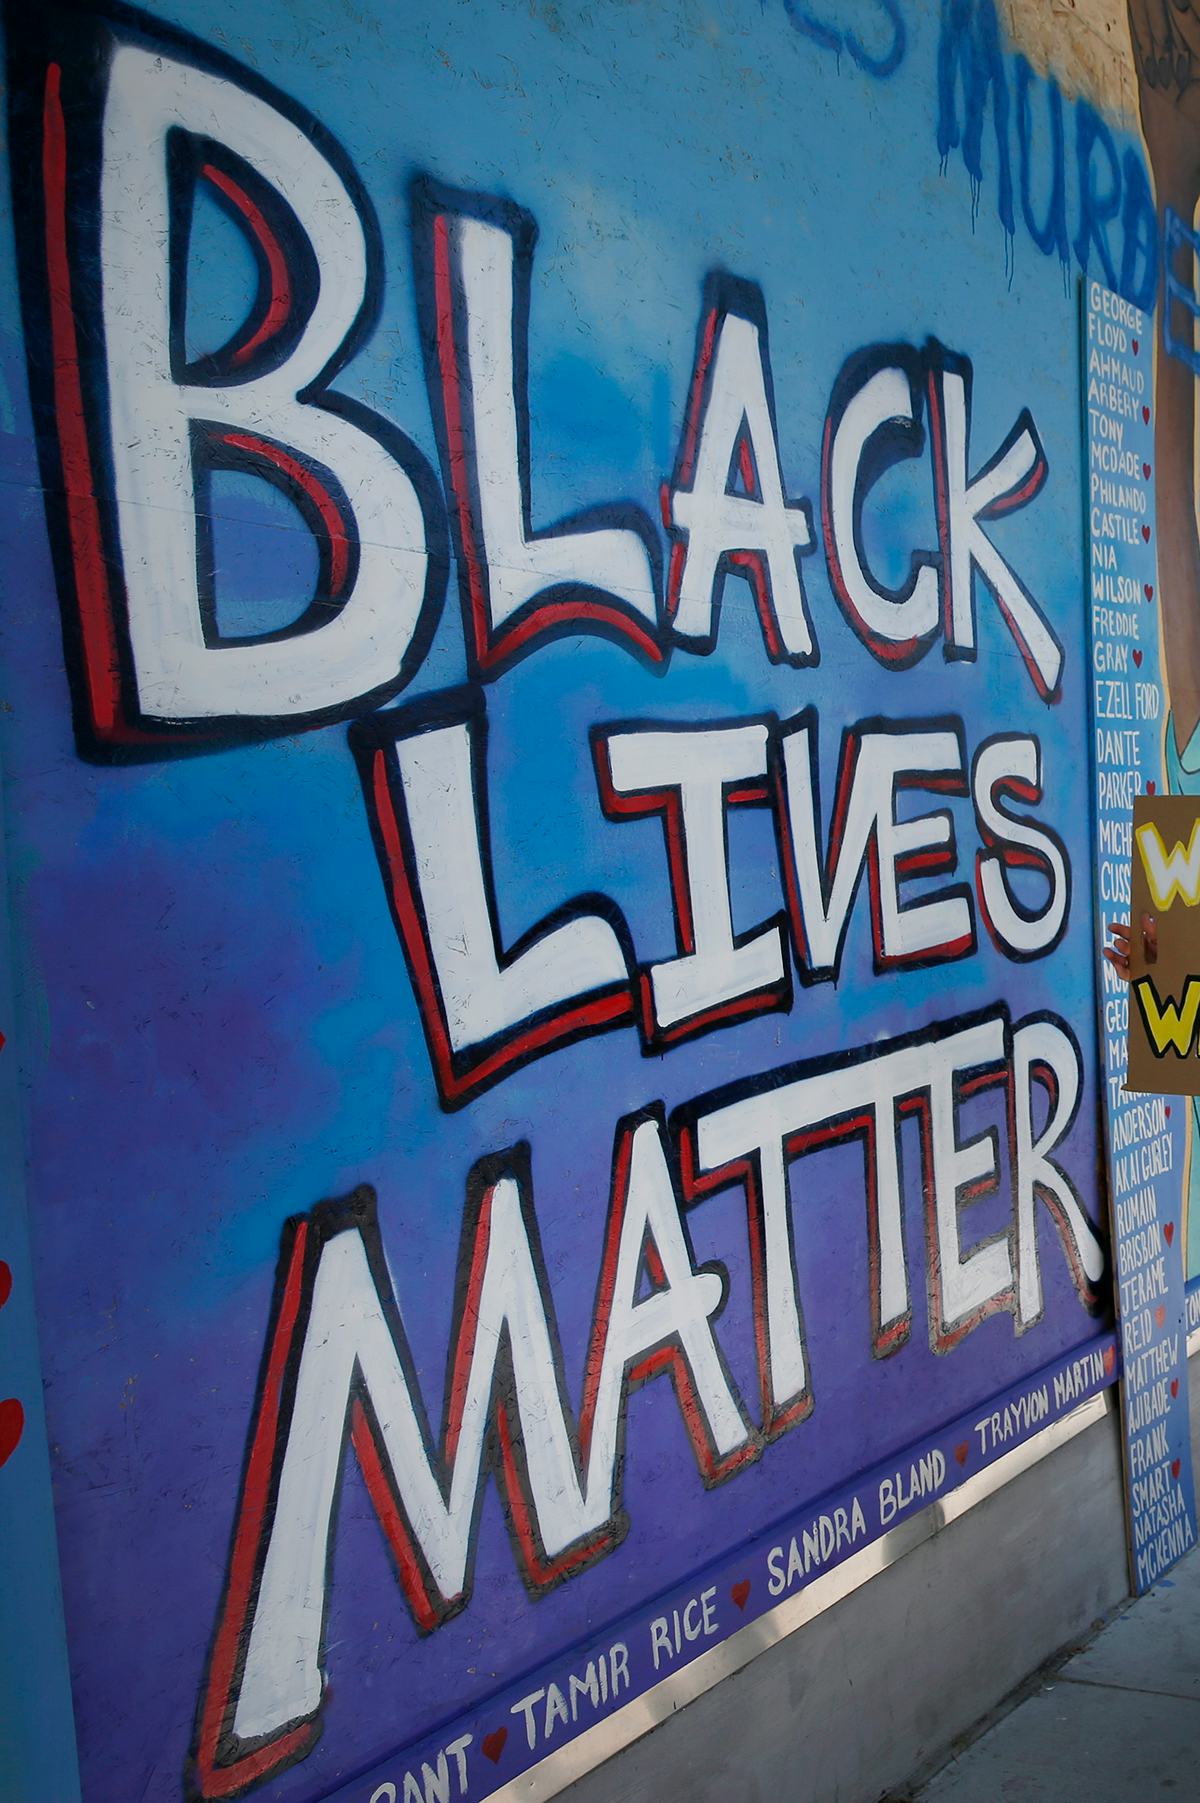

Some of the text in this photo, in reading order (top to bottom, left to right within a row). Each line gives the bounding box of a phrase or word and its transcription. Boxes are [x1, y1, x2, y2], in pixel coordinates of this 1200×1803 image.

[1088, 312, 1127, 353] FLOYD
[1090, 282, 1142, 335] GEORGE
[30, 5, 1064, 760] BLACK
[1089, 348, 1144, 394] AHMAUD
[1088, 377, 1139, 422] ARBERY
[1089, 408, 1123, 450] TONY
[1091, 441, 1140, 480] MCDADE
[1091, 473, 1146, 514] PHILANDO
[1090, 507, 1140, 545] CASTILE
[1092, 543, 1117, 570] NIA
[1092, 572, 1141, 605] WILSON
[1092, 606, 1139, 640] FREDDIE
[1093, 641, 1129, 674] GRAY
[1096, 680, 1159, 720] EZELL FORD
[1097, 728, 1141, 766] DANTE
[1099, 771, 1141, 810] PARKER
[350, 690, 1072, 1110] LIVES
[1113, 1097, 1166, 1154] ANDERSON
[1141, 1132, 1173, 1181] GURLEY
[1116, 1184, 1157, 1240] RUMAIN
[1119, 1220, 1161, 1277] BRISBON
[1121, 1257, 1168, 1317] JERAME
[1124, 1309, 1152, 1357] REID
[1126, 1333, 1178, 1400] MATTHEW
[188, 1003, 1110, 1800] MATTER
[1128, 1377, 1170, 1437] AJIBADE
[1130, 1419, 1169, 1478] FRANK
[1132, 1460, 1171, 1518] SMART
[1134, 1482, 1186, 1549] NATASHA
[510, 1642, 631, 1752] TAMIR
[651, 1586, 720, 1669] RICE
[767, 1497, 867, 1597] SANDRA
[879, 1449, 946, 1525] BLAND
[974, 1383, 1049, 1455] TRAYVON
[1053, 1349, 1105, 1410] MARTIN
[1137, 1513, 1194, 1588] MCKENNA
